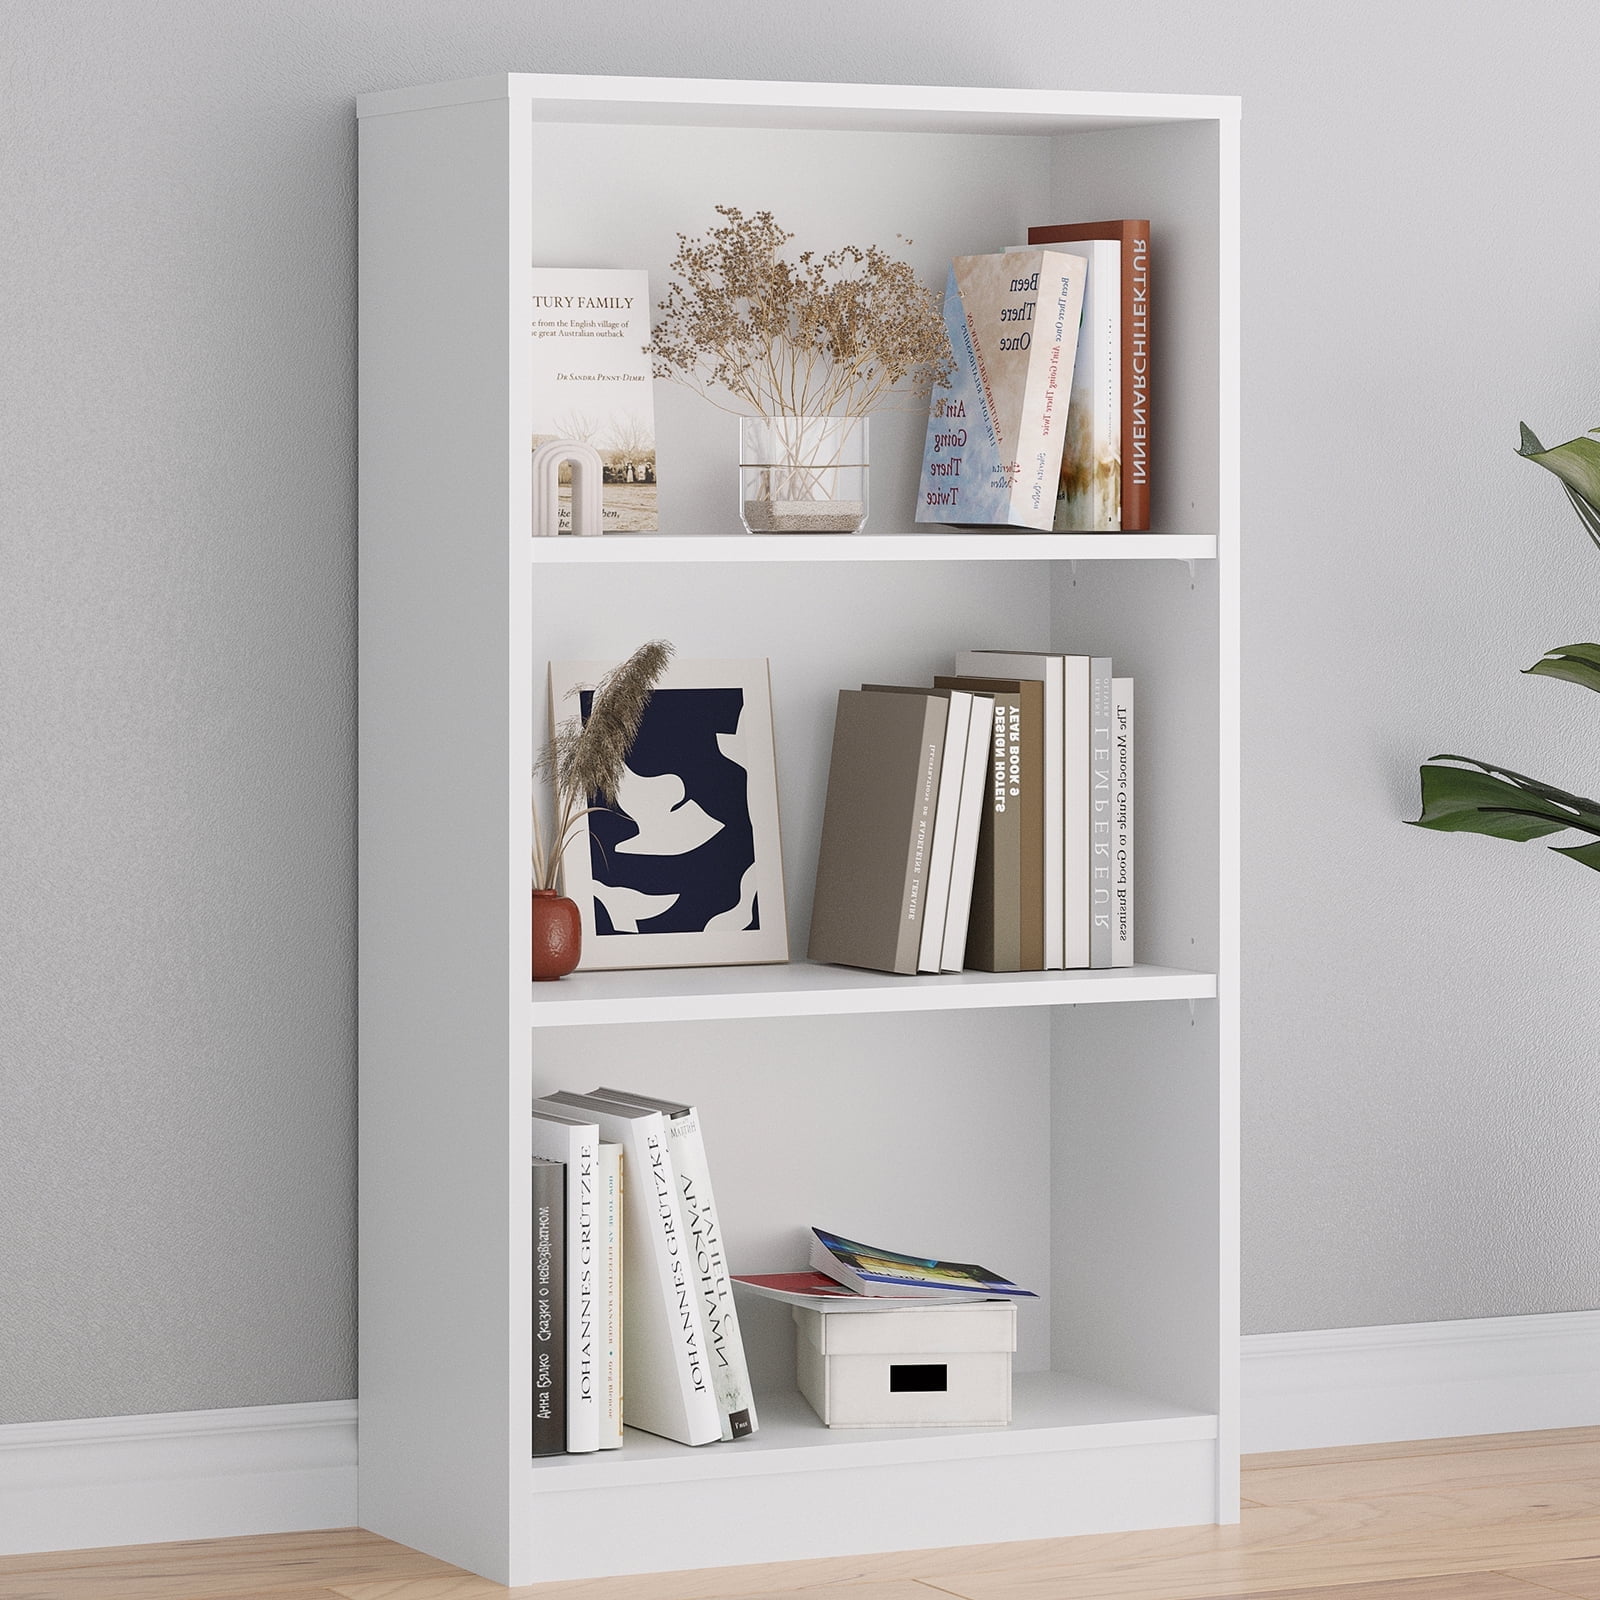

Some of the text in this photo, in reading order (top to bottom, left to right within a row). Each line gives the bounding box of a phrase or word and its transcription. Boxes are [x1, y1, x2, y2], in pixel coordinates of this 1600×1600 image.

[538, 319, 555, 327] from
[570, 320, 596, 330] English
[598, 320, 619, 330] village
[621, 320, 629, 328] of
[538, 331, 556, 339] great
[596, 330, 624, 338] outback
[578, 297, 634, 309] FAMILY
[608, 1201, 613, 1212] TO
[702, 1199, 727, 1301] ТАНЕЦ
[536, 1206, 552, 1419] Анна Бялко Сказки о невозвратном
[580, 1144, 592, 1404] JOHANNES GRÜTZKE
[648, 1135, 706, 1393] JOHANNES GRÜTZKE
[681, 1174, 728, 1368] ДРАКОНАМИ
